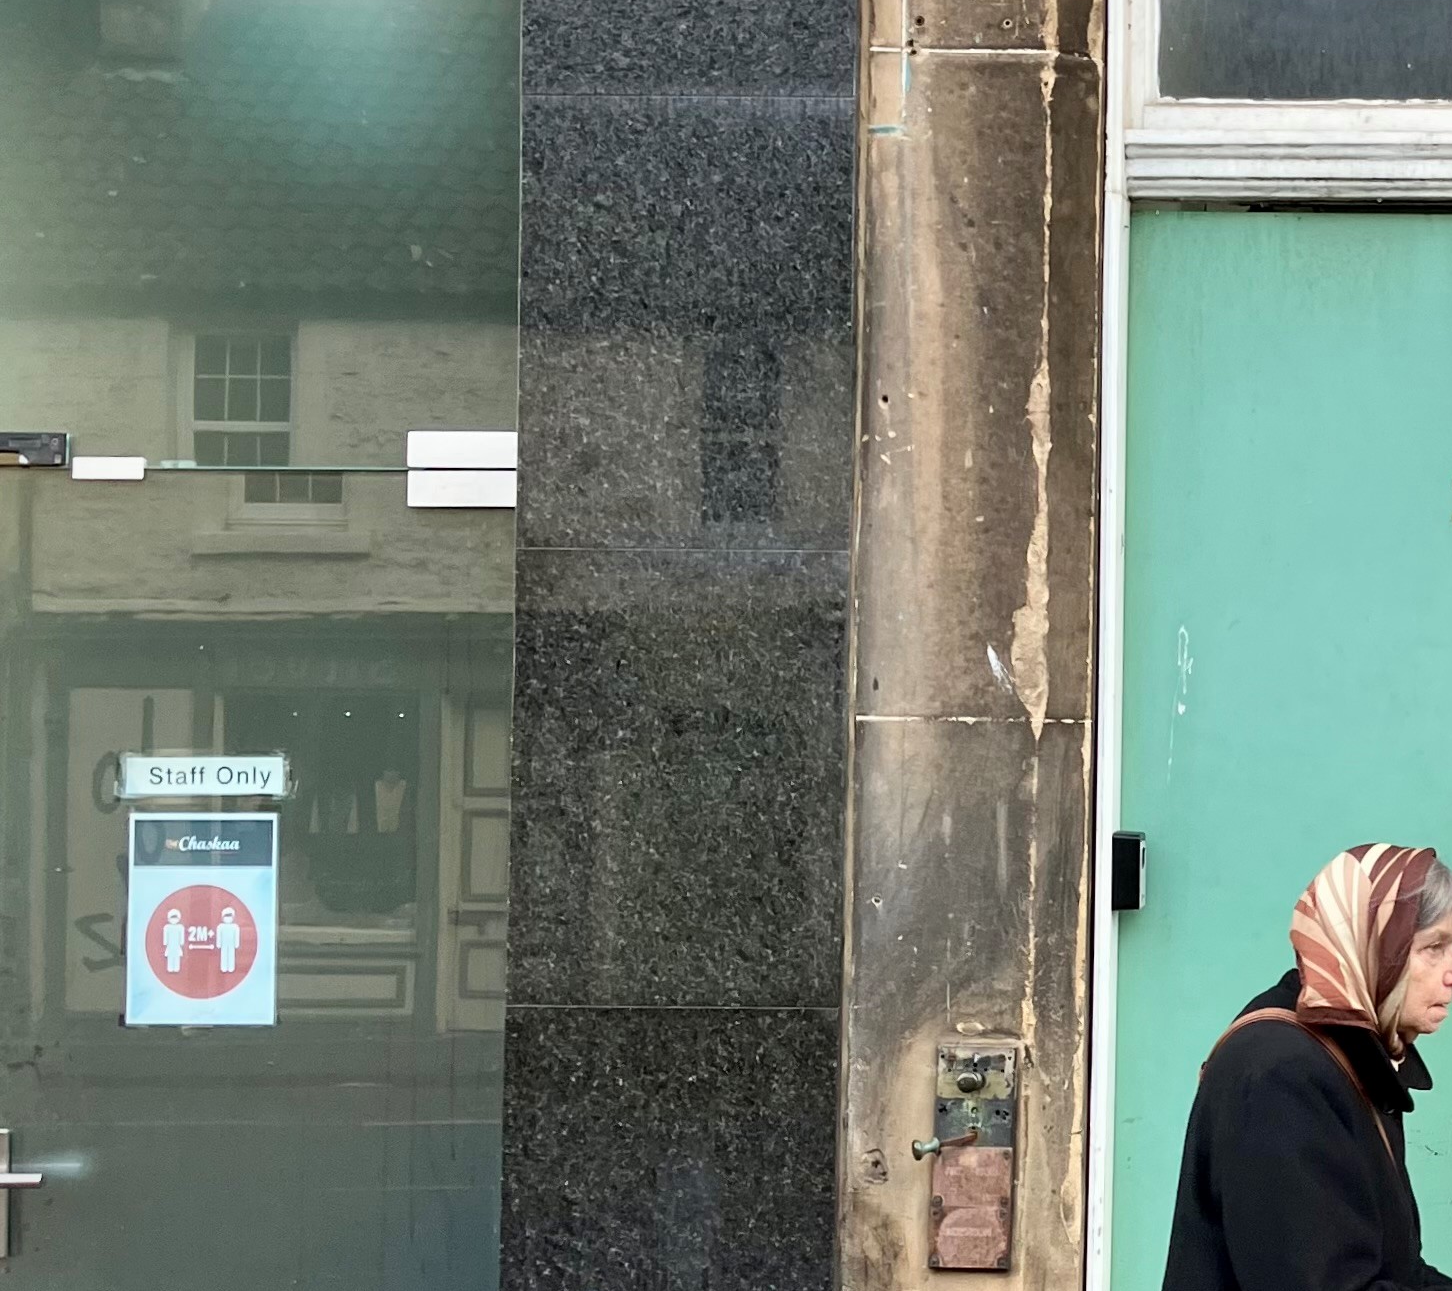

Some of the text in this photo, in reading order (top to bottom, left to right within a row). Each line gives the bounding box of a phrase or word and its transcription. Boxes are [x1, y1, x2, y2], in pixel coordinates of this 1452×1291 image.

[150, 766, 272, 789] Staff Only
[179, 835, 240, 851] Chaskaa
[187, 926, 215, 942] 2M+
